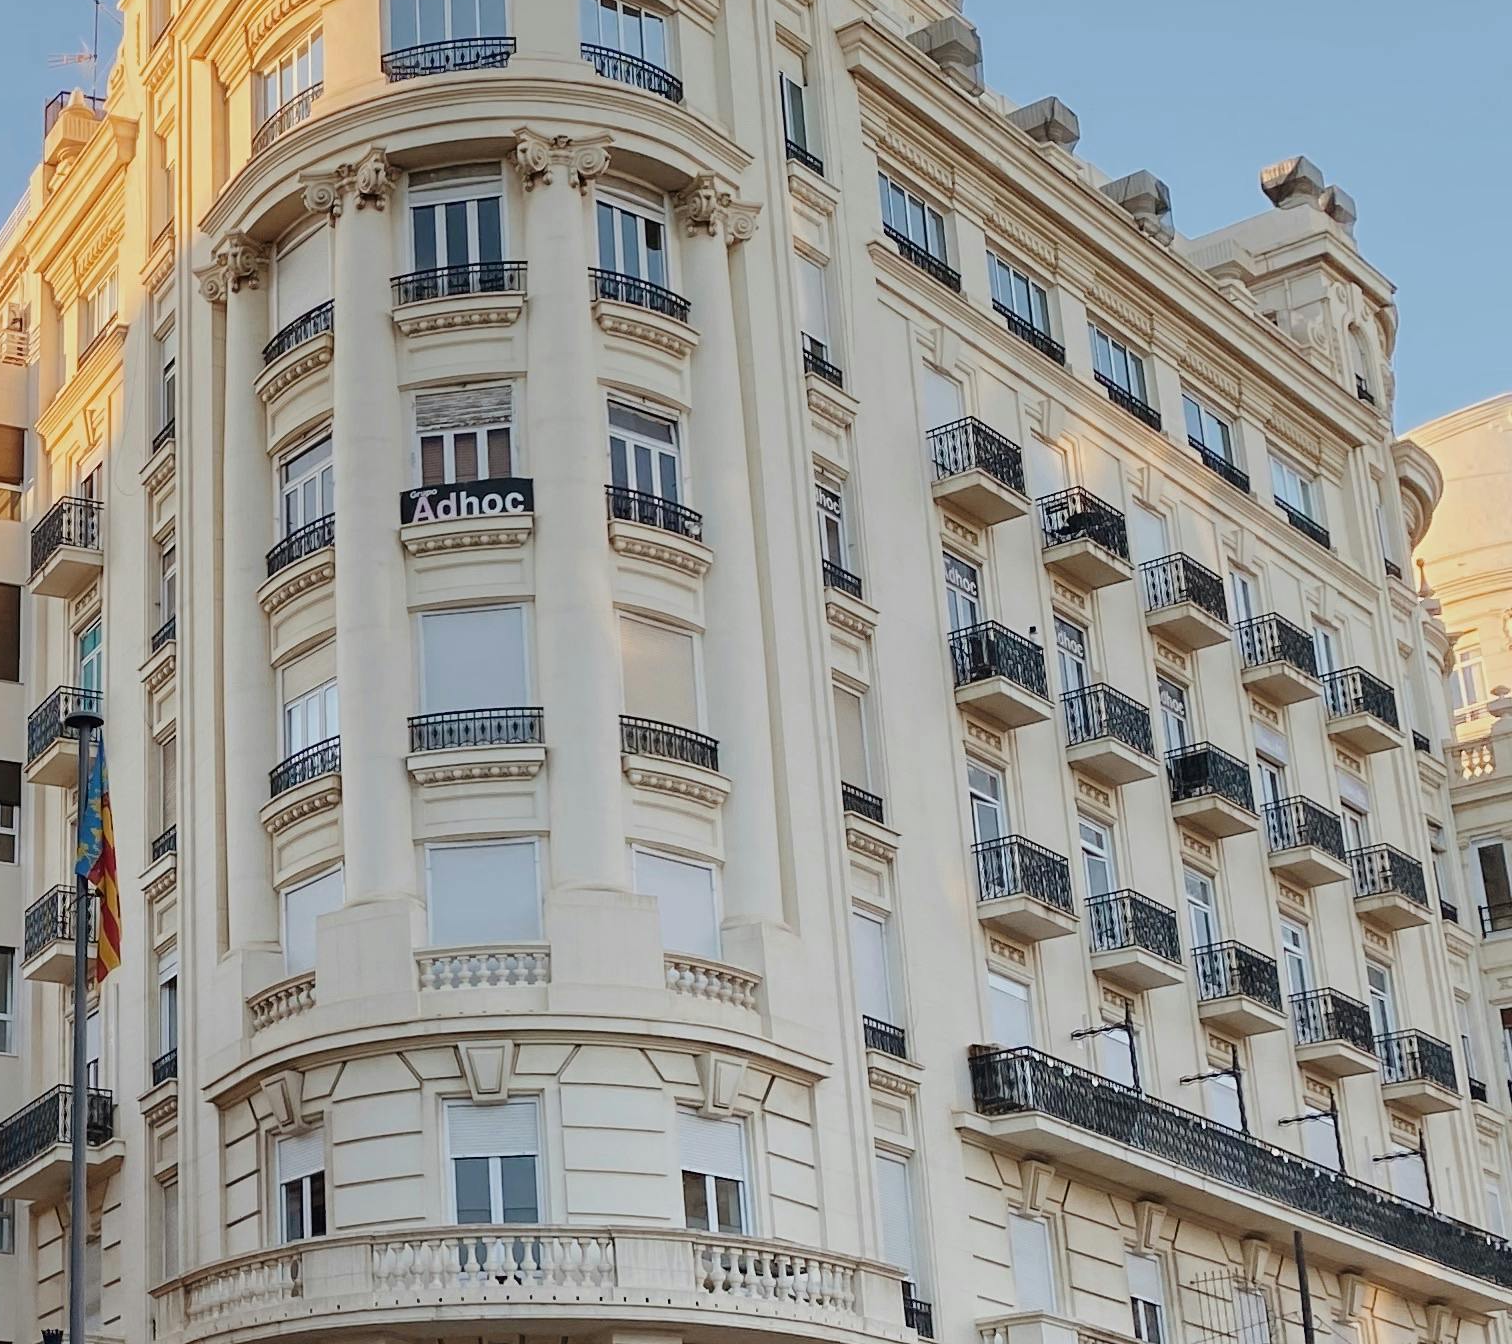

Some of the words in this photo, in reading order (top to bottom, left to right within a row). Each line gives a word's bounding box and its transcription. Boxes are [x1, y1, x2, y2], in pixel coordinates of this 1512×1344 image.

[410, 489, 438, 500] Grupo
[412, 491, 526, 523] Adhoc
[946, 567, 977, 596] dhoc
